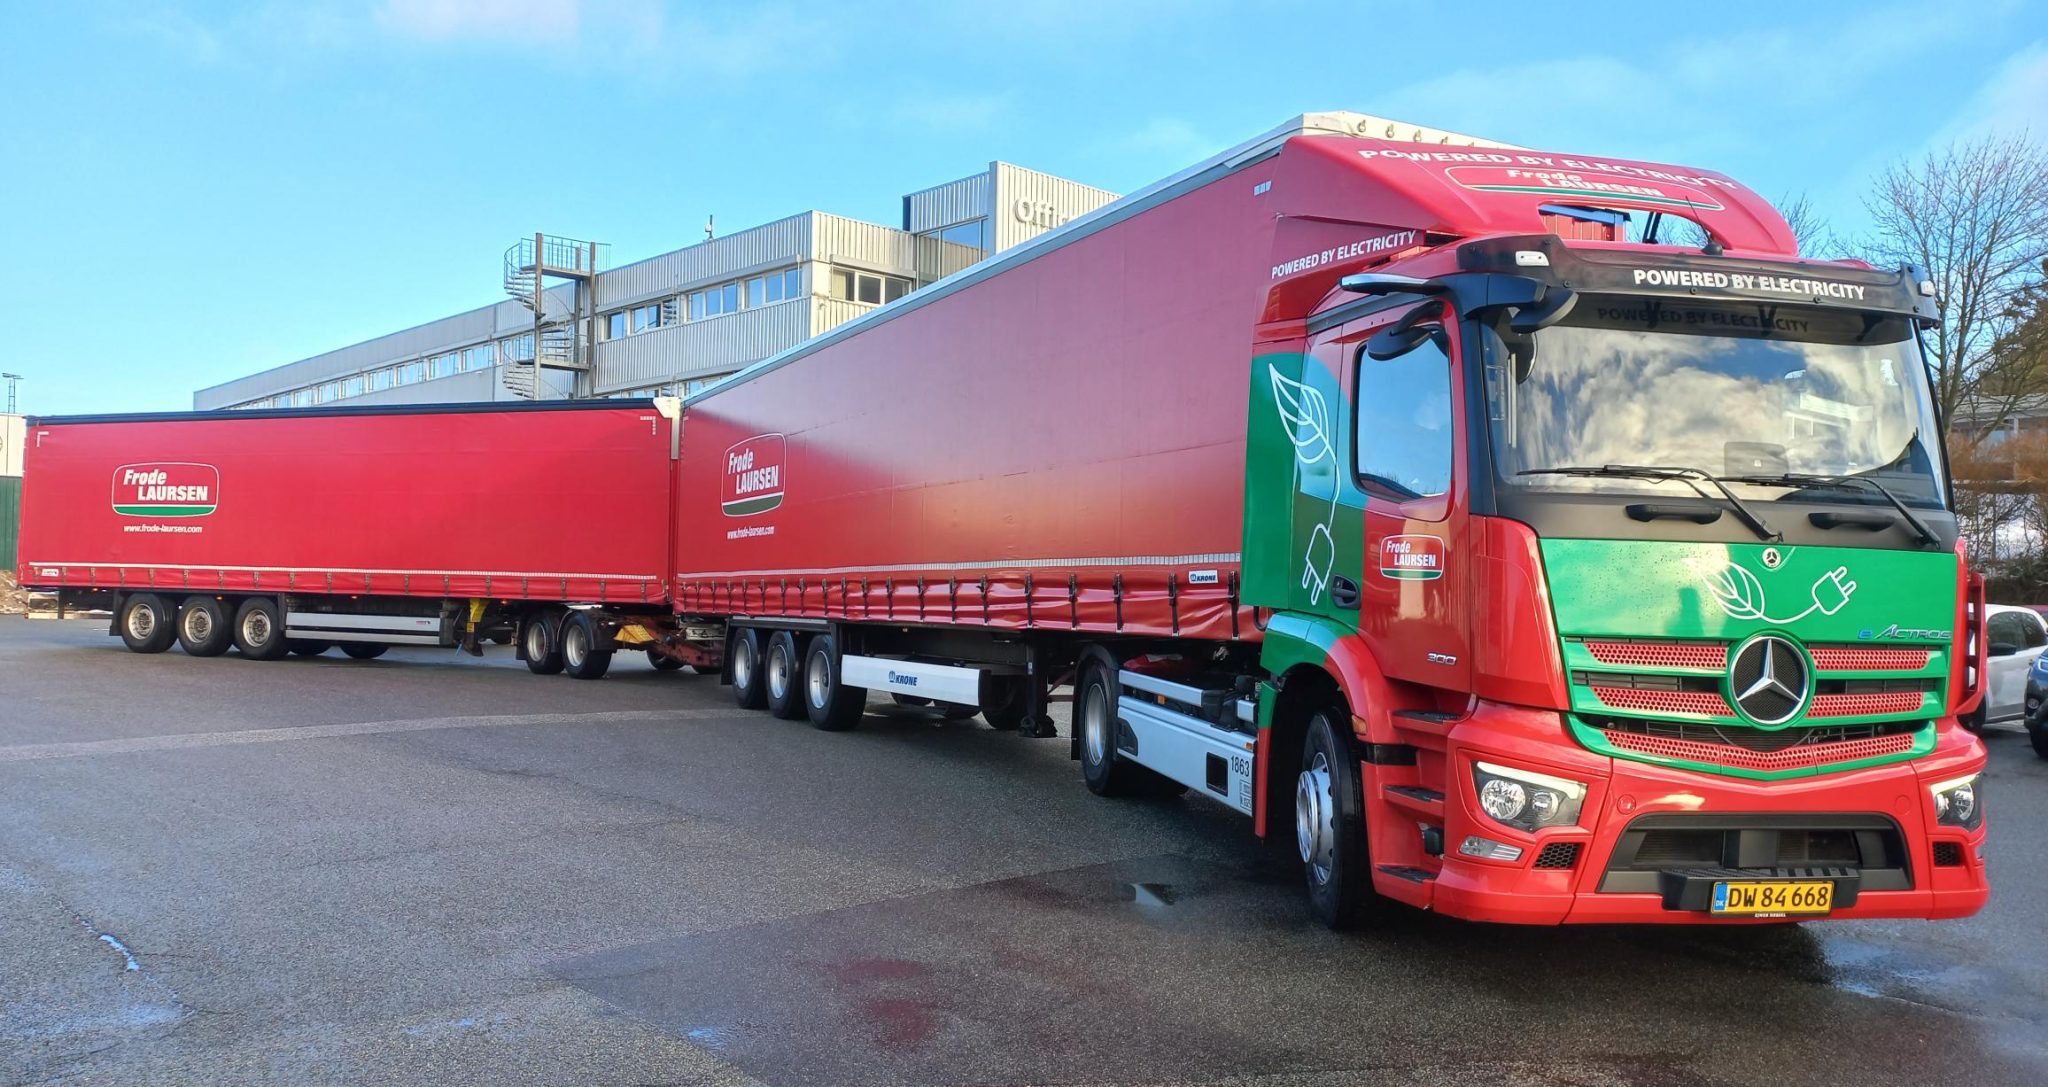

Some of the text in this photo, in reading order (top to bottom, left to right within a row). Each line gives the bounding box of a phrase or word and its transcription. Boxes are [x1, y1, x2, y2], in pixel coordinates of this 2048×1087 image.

[1358, 150, 1738, 190] POWERED BY ELECTRICITY
[1506, 169, 1582, 183] Frode
[1541, 177, 1665, 197] LAURSEN
[1271, 230, 1417, 280] POWERED BY ELECTRICITY
[1633, 269, 1866, 301] POWERED BY ELECTRICITY
[1597, 308, 1682, 323] POWEED
[1712, 313, 1809, 334] ELECTCITY
[728, 448, 753, 475] Frode
[123, 468, 167, 486] Frode
[736, 465, 779, 494] LAURSEN
[137, 485, 208, 501] LAURSEN
[123, 523, 203, 534] www.frode-laursen.com
[727, 525, 775, 540] www.frode-laursen.com
[1385, 540, 1411, 553] Frode
[1394, 553, 1436, 567] LAURSEN
[1427, 652, 1457, 666] 300
[896, 674, 918, 686] KRONE
[1231, 755, 1250, 777] 1863
[1728, 886, 1828, 907] DW 84 668
